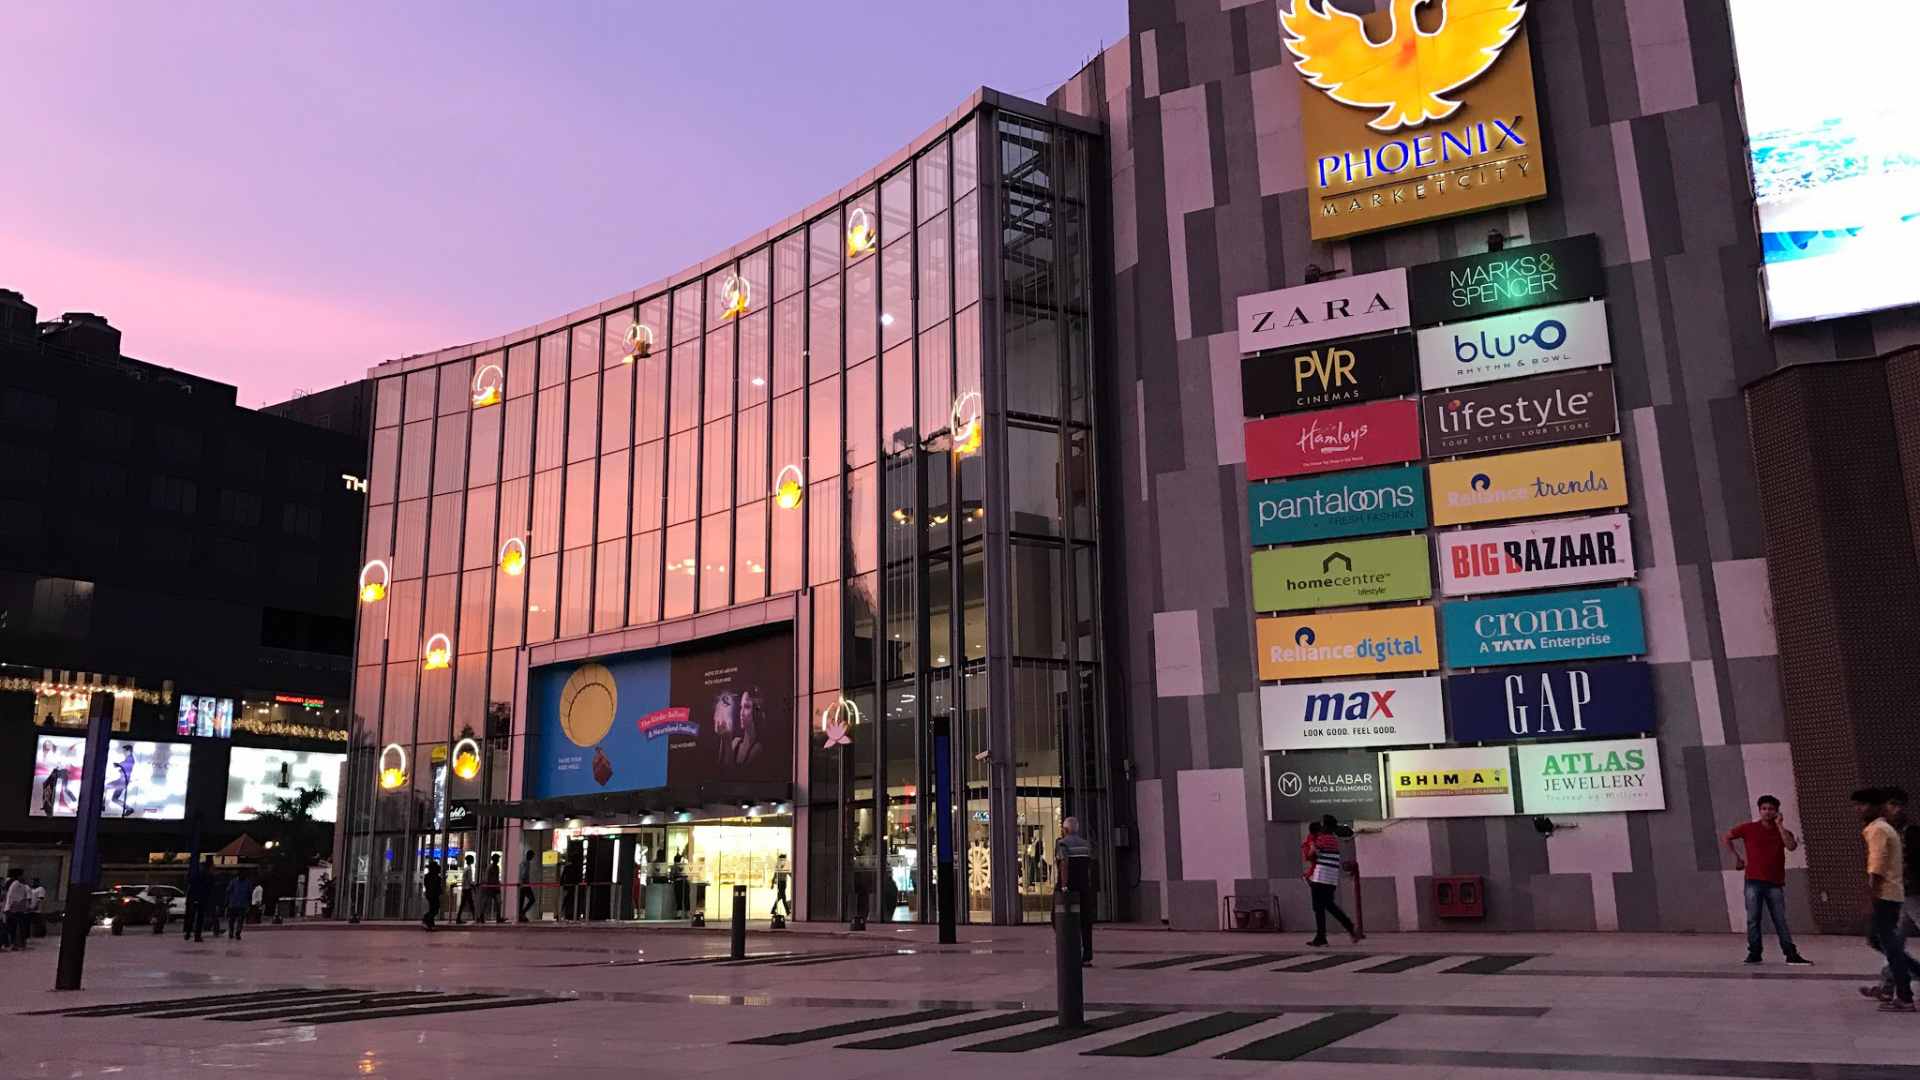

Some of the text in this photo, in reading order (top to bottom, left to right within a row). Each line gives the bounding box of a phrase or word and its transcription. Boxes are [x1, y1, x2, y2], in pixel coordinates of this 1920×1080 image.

[1317, 115, 1527, 189] PHOENIX
[1322, 160, 1530, 217] MARKETCITY
[1451, 271, 1559, 308] SPENCER
[1251, 292, 1395, 333] ZARA
[1294, 347, 1358, 393] PVR
[1297, 389, 1360, 406] CINEMAS
[1438, 389, 1590, 433] lifestyle
[1296, 418, 1368, 453] Hamleys
[1530, 470, 1609, 498] trends
[1258, 485, 1415, 528] pantaloons
[1451, 530, 1617, 579] BIG BAZAAR
[1271, 635, 1422, 663] Reliance digital
[1479, 632, 1611, 653] A TATA Enterprise
[1304, 690, 1396, 722] max
[1504, 670, 1591, 735] GAP
[1303, 728, 1324, 737] LOOK
[1353, 727, 1371, 735] FEEL
[1541, 749, 1646, 776] ATLAS
[1308, 773, 1373, 785] MALABAR
[1335, 784, 1374, 792] DIAMONDS
[1400, 773, 1484, 786] BHIMA
[1544, 774, 1646, 792] JEWELLERY
